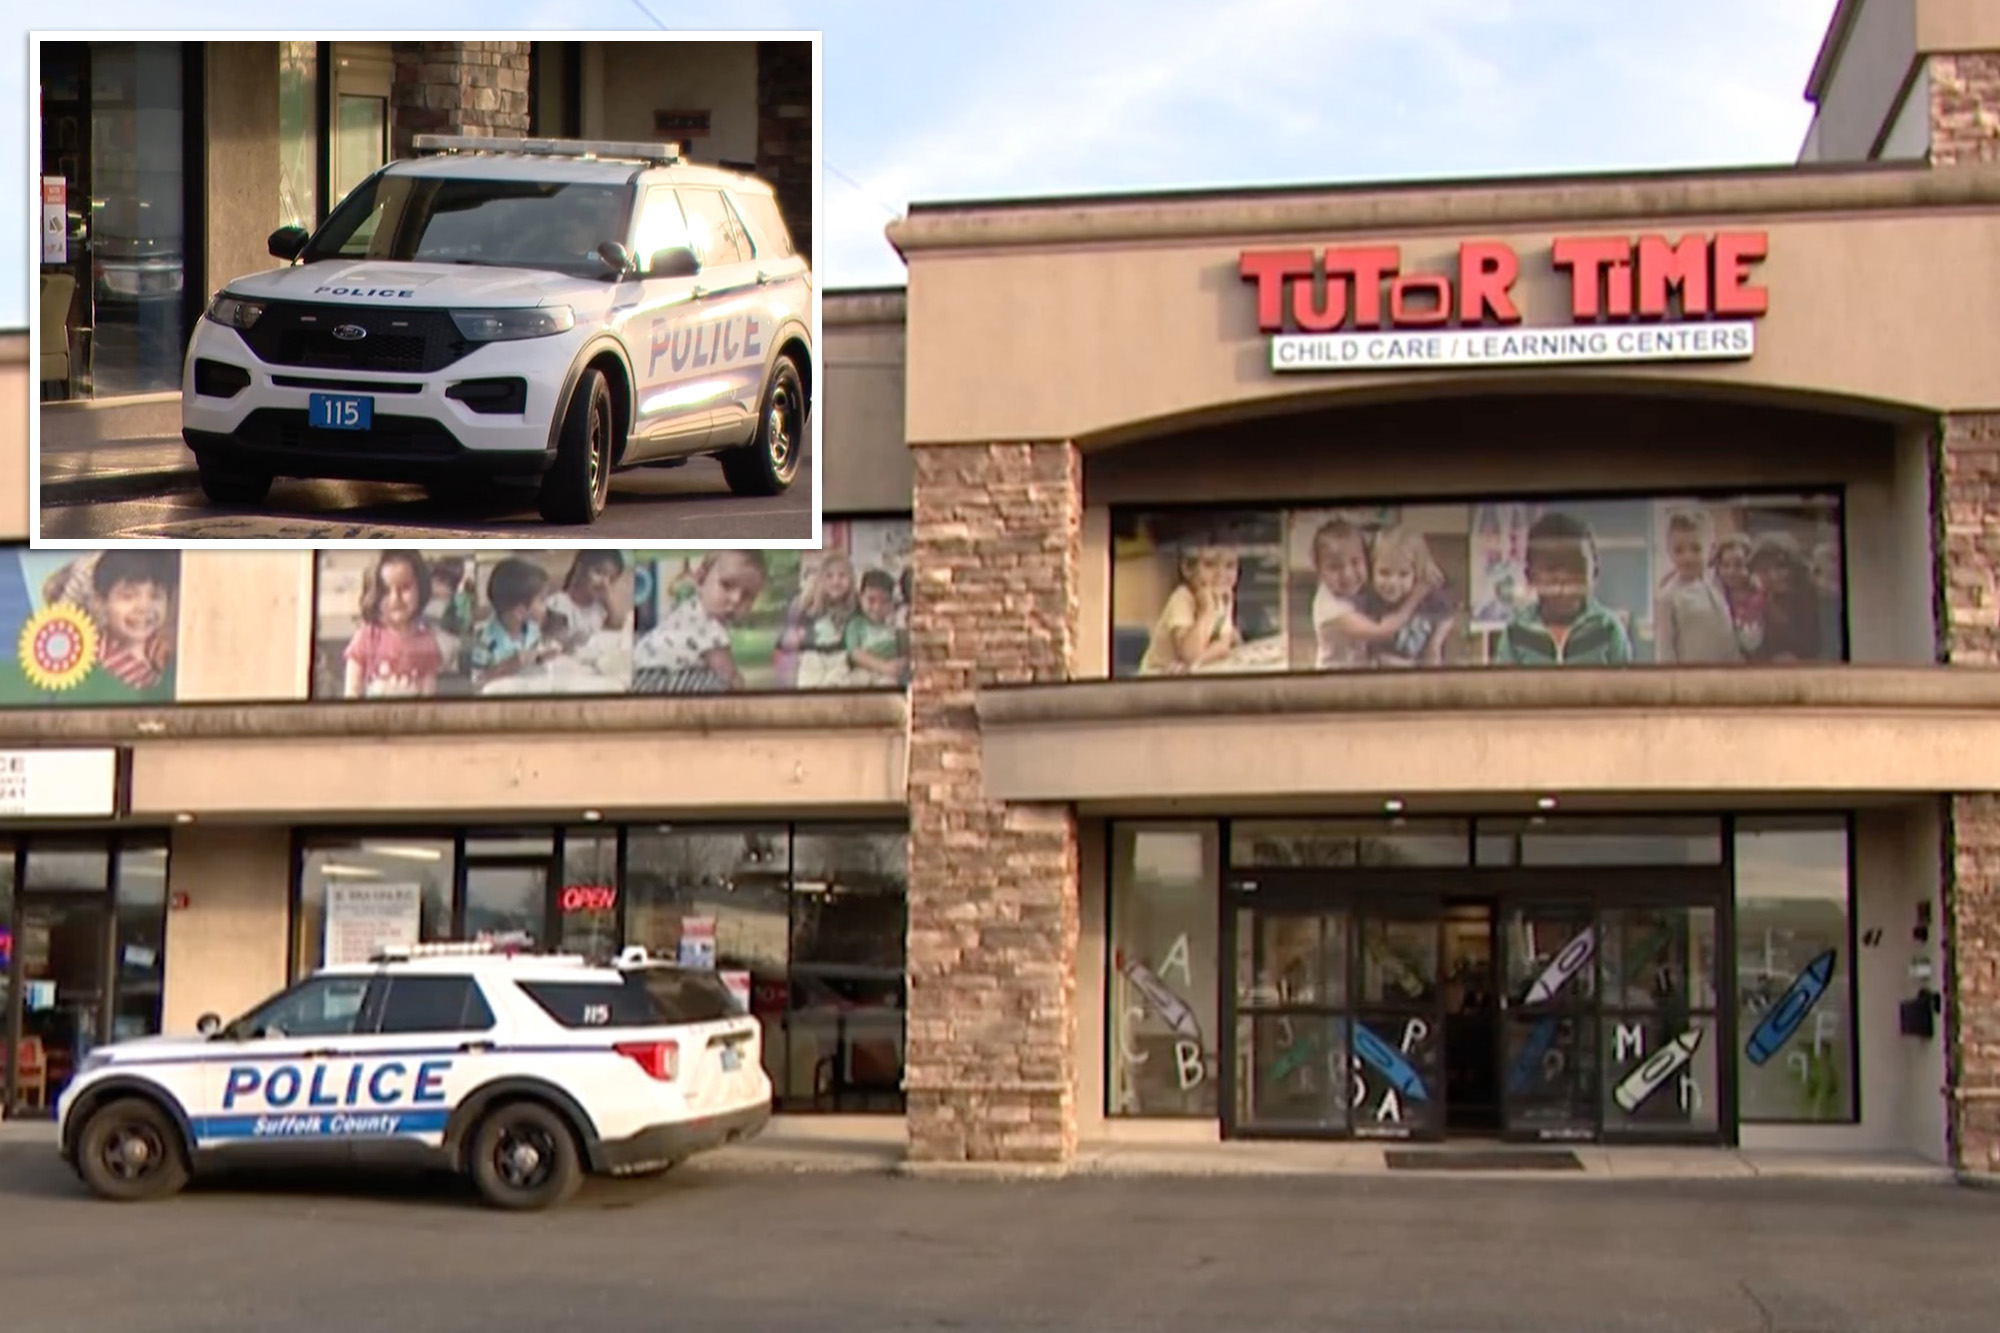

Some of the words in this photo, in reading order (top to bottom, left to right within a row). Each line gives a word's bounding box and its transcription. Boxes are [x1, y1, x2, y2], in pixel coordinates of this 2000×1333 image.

[313, 286, 414, 299] POLICE
[648, 313, 761, 378] POLICE
[1278, 341, 1359, 363] CHILD
[1367, 338, 1442, 361] CARE
[1451, 338, 1461, 358] /
[1467, 332, 1608, 358] LEARNING
[1616, 327, 1749, 353] CENTERS
[323, 400, 360, 426] 115
[563, 887, 617, 911] OPEN
[1157, 932, 1192, 988] A
[583, 1004, 609, 1025] 115
[1401, 1018, 1428, 1054] P
[1615, 1023, 1644, 1063] M
[1175, 1039, 1204, 1091] B
[222, 1060, 453, 1110] POLICE
[253, 1115, 323, 1135] Suffolk
[330, 1112, 401, 1134] County
